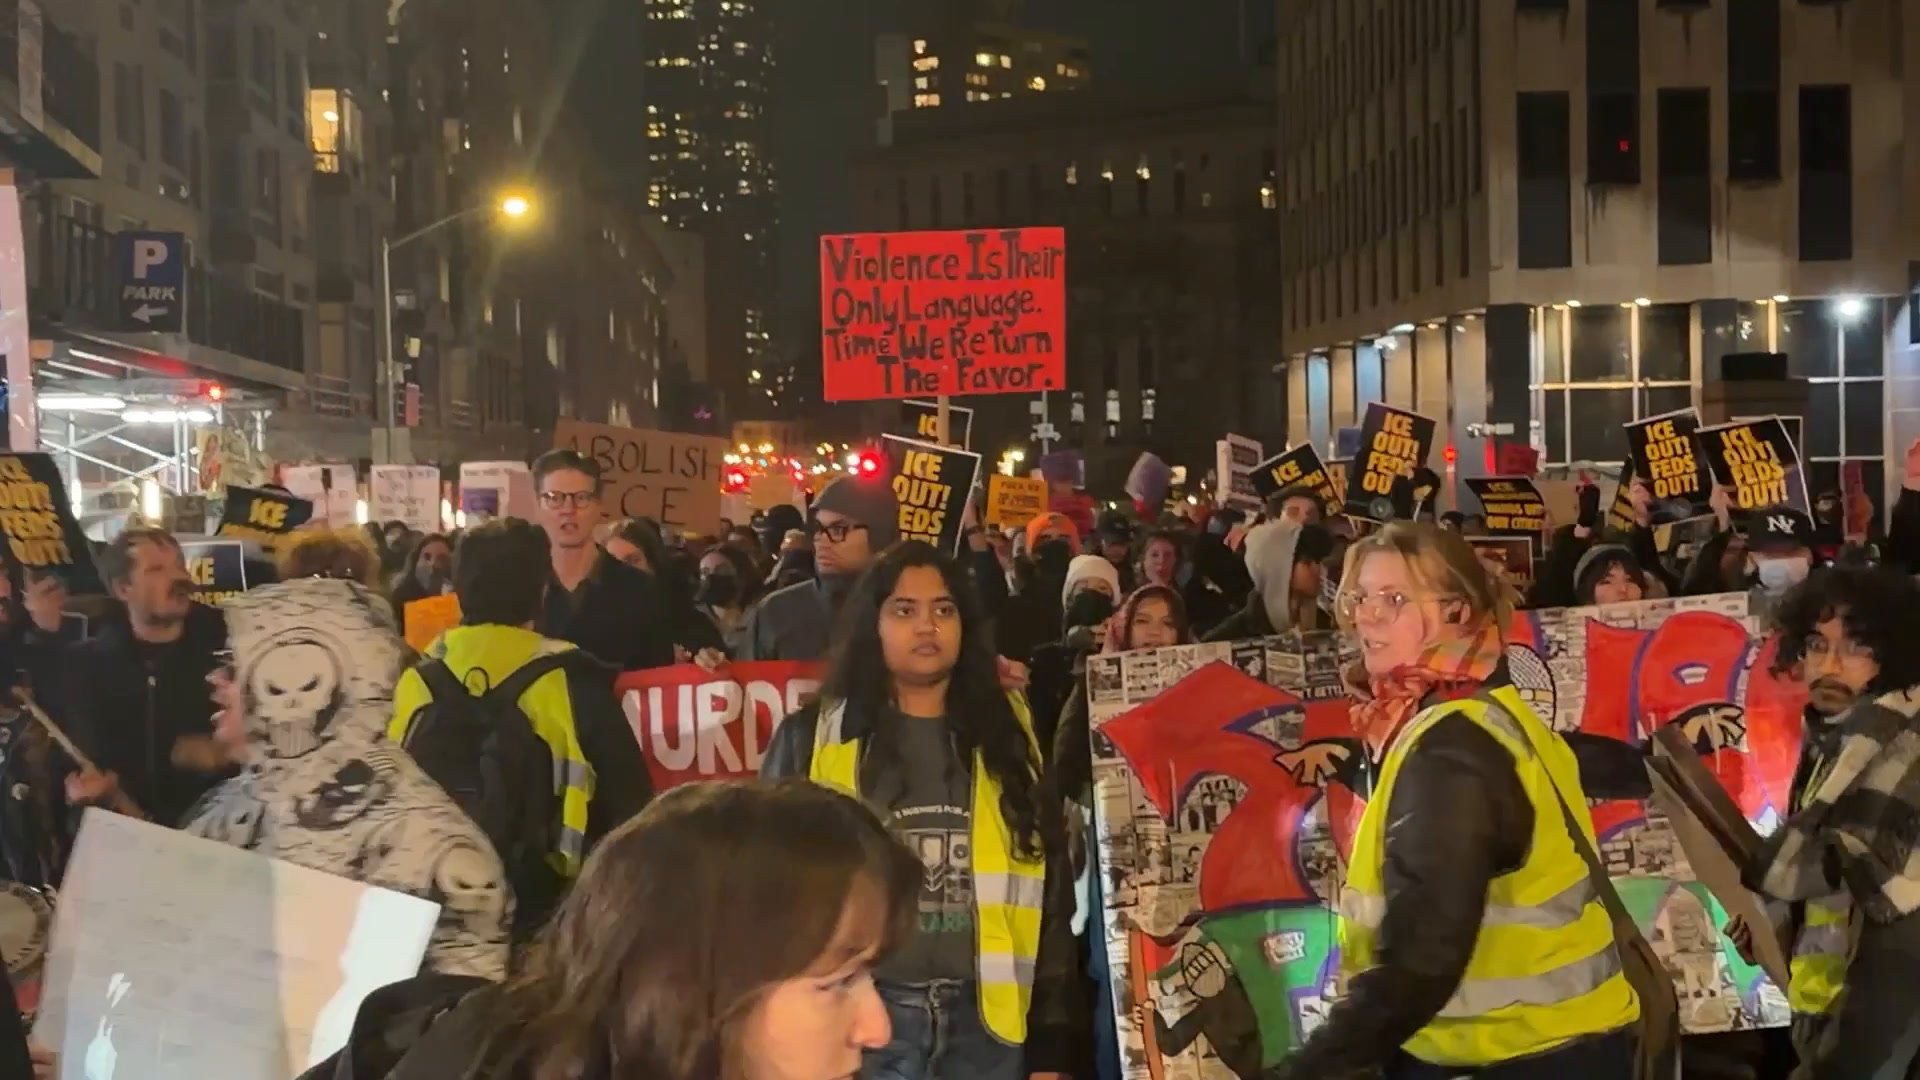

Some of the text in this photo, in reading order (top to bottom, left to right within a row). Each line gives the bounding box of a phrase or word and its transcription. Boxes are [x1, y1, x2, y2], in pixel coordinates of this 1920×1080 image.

[133, 239, 168, 279] P
[825, 230, 1063, 282] Violence Is Their
[122, 286, 176, 301] PARK
[831, 283, 1042, 335] Only Language.
[823, 320, 1052, 361] Time We Return
[876, 355, 1053, 394] The Favor.
[918, 412, 938, 436] IC
[1383, 411, 1413, 437] ICE
[1645, 419, 1676, 442] ICE
[1373, 431, 1419, 461] OUT!
[1645, 435, 1692, 460] OUT!
[903, 450, 942, 481] ICE
[1650, 452, 1697, 480] FEDS
[1731, 461, 1785, 490] FEDS
[892, 474, 952, 510] OUT!
[1362, 471, 1394, 495] OU
[1654, 473, 1699, 499] OUT!
[1738, 478, 1789, 509] OUT!
[248, 498, 289, 529] ICE
[898, 503, 946, 535] EDS
[190, 556, 216, 586] CE
